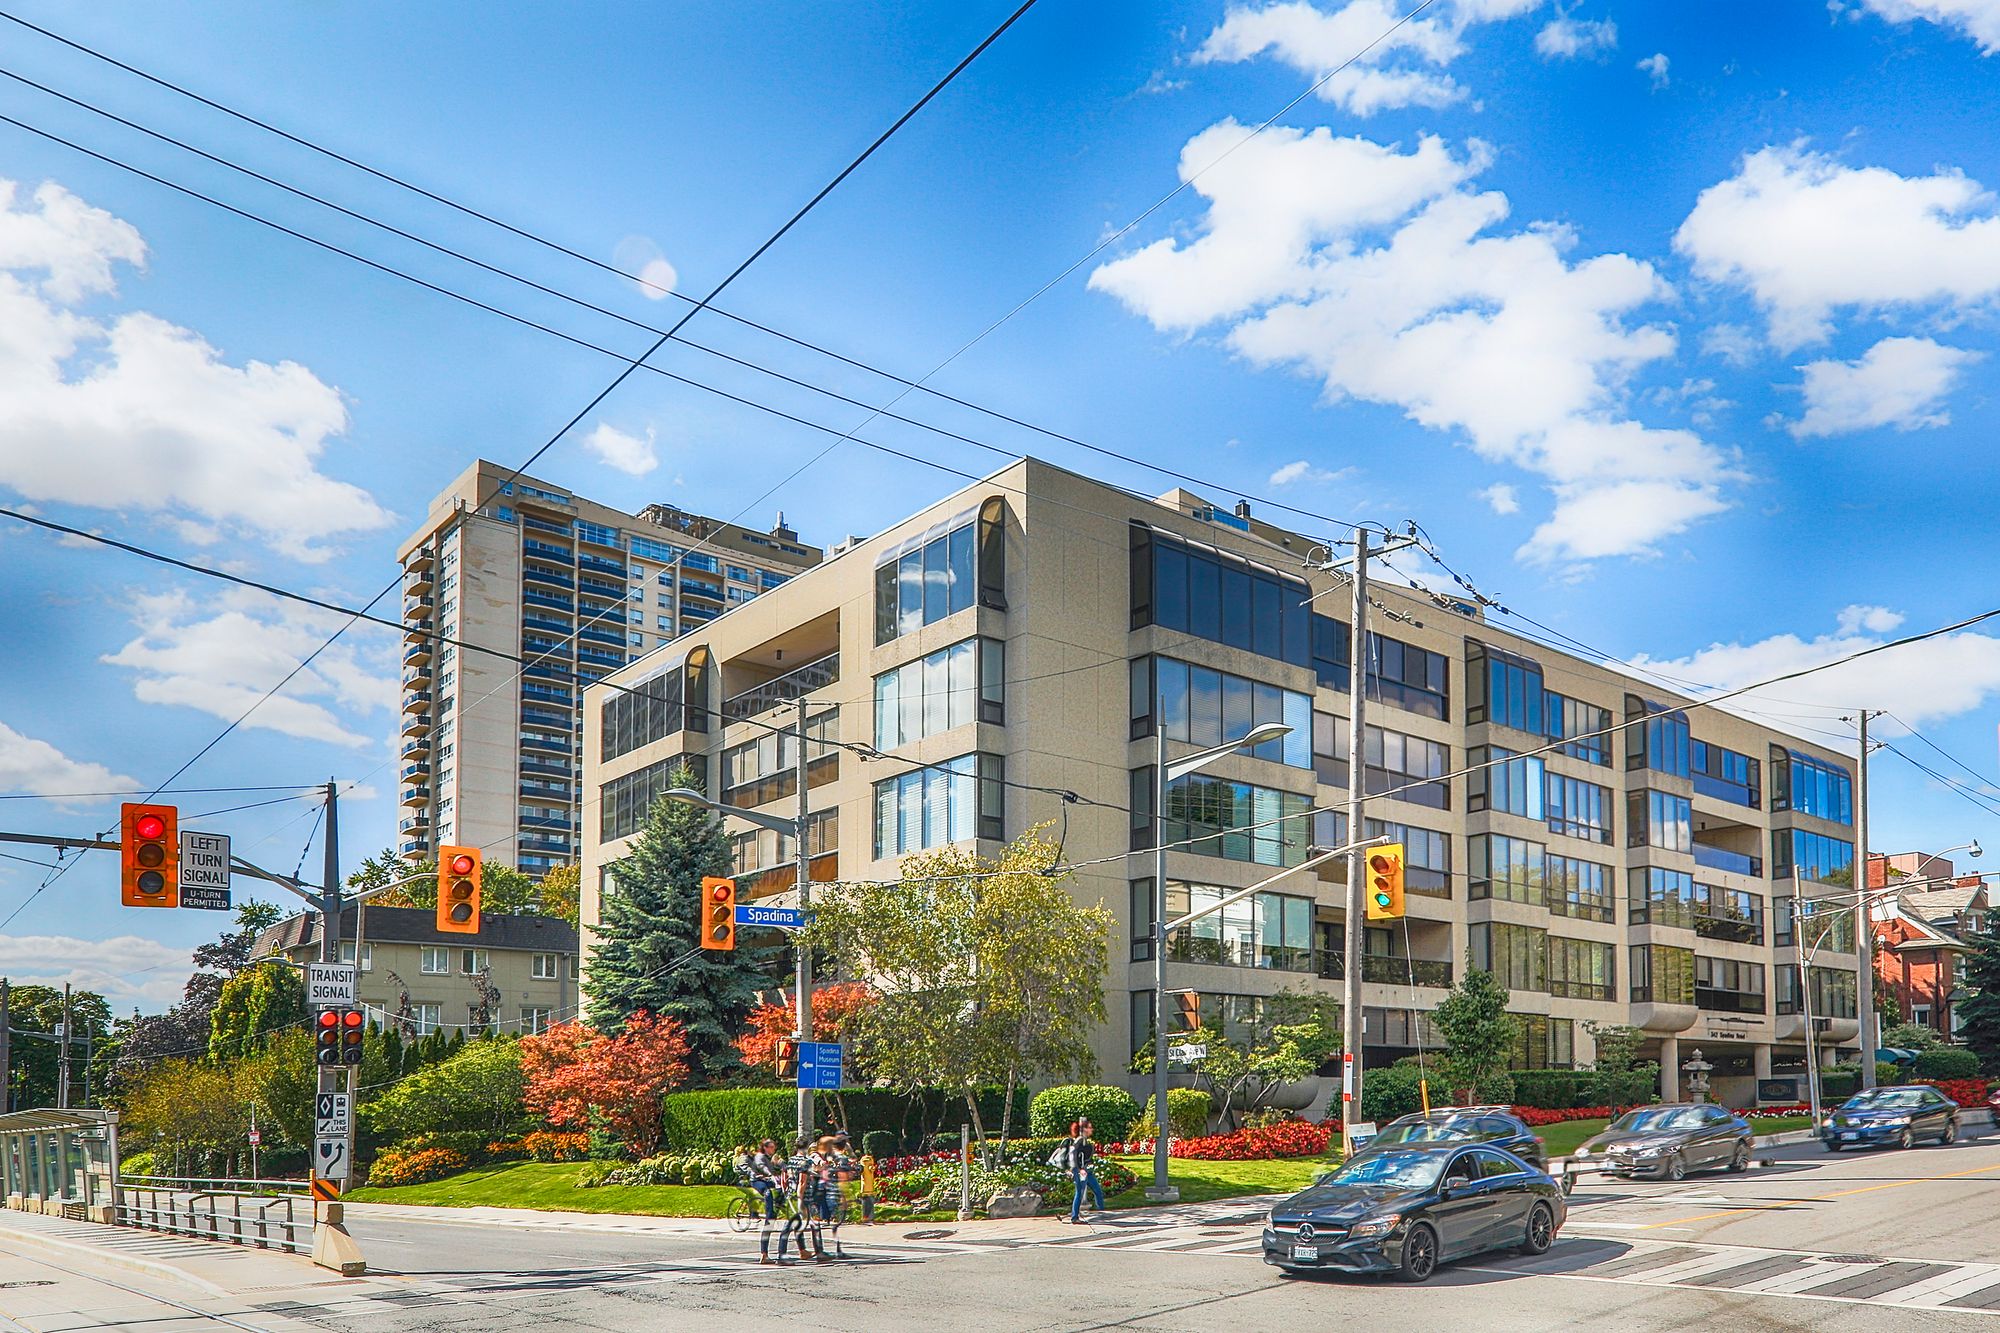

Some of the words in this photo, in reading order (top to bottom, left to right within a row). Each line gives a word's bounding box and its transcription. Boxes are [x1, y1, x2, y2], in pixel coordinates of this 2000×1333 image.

[191, 836, 221, 851] LEFT
[190, 853, 222, 867] TURN
[184, 869, 227, 884] SIGNAL
[190, 890, 221, 899] U-TURN
[183, 898, 228, 908] PERMITTED
[748, 908, 794, 923] Spadina
[311, 969, 353, 982] TRANSIT
[313, 985, 351, 999] SIGNAL
[819, 1047, 840, 1055] Spadina
[821, 1078, 836, 1086] Loma
